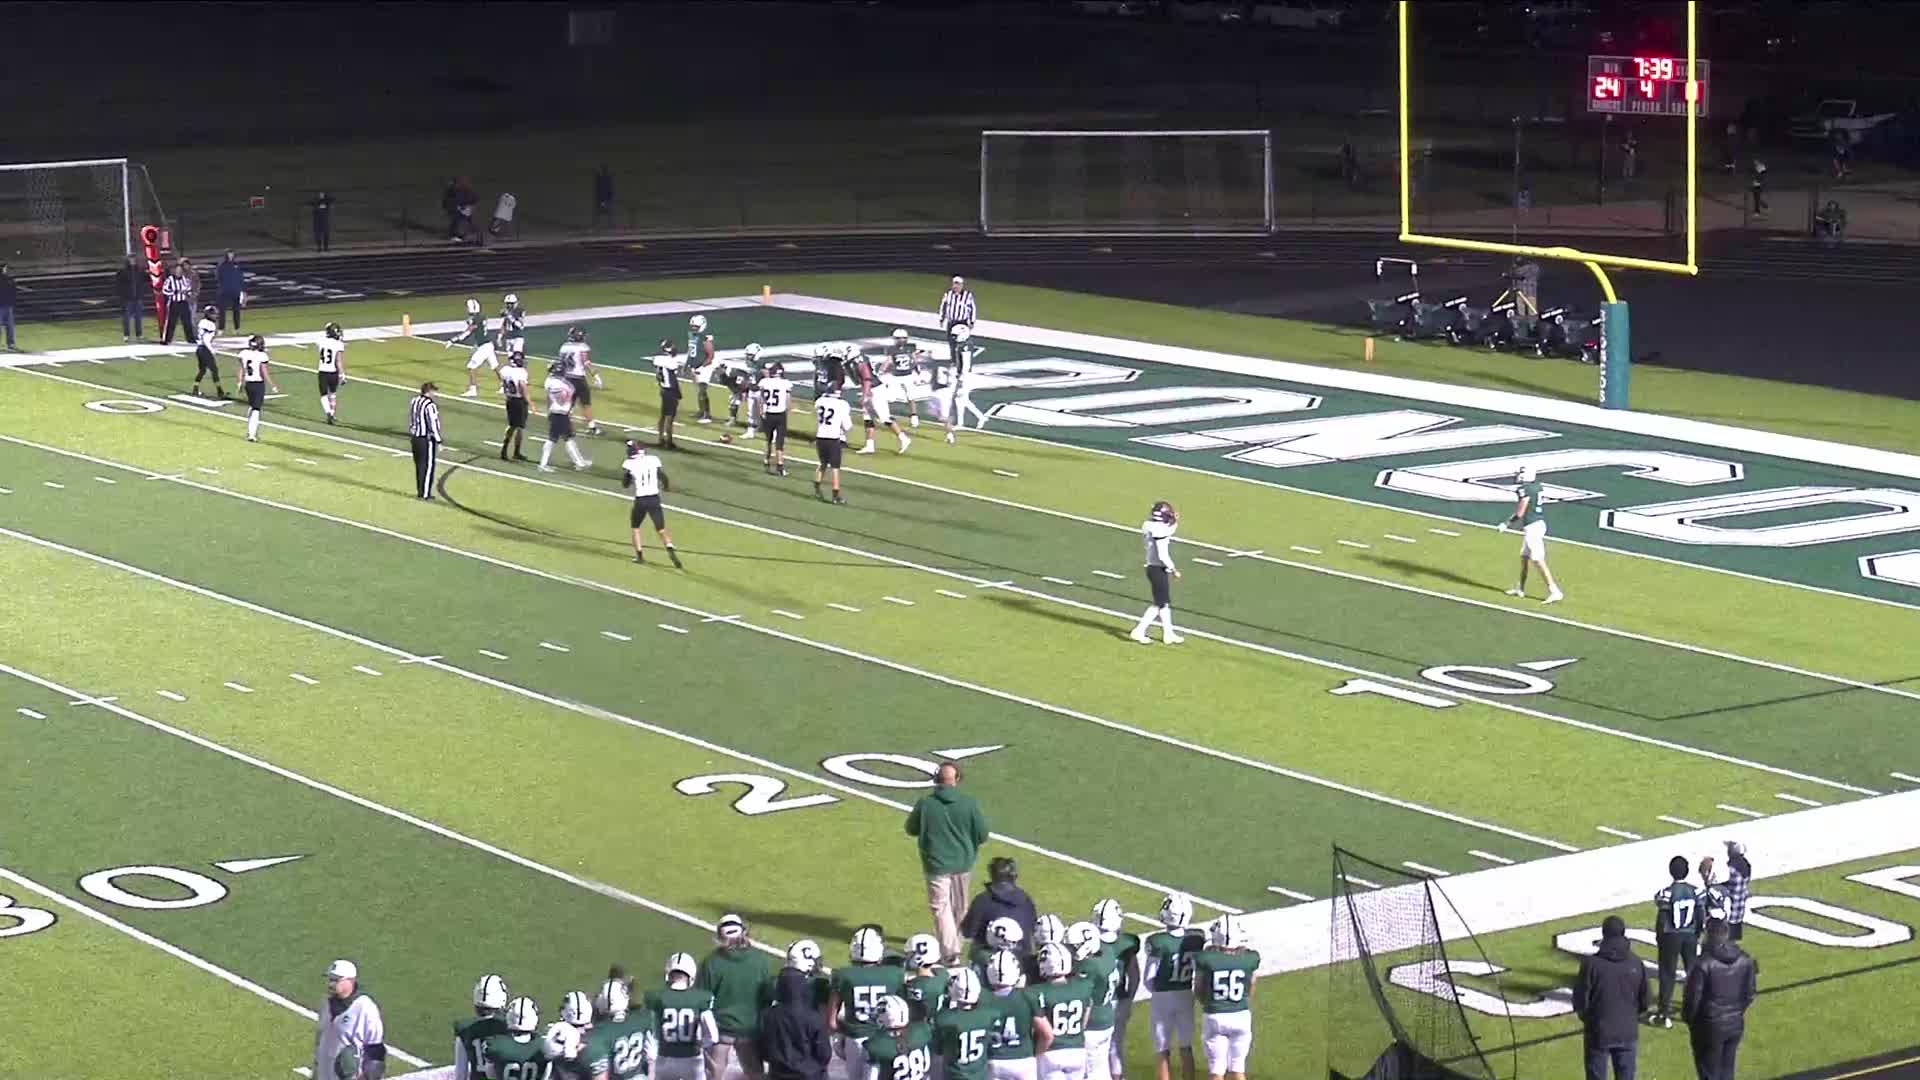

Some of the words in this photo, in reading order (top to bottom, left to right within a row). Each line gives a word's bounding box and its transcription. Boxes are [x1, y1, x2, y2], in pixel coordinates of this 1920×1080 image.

[1634, 57, 1673, 79] 7:39
[1595, 77, 1619, 98] 24
[1640, 80, 1653, 98] 4
[319, 346, 334, 365] 43
[763, 389, 780, 407] 25
[816, 404, 836, 426] 32
[641, 334, 1920, 590] BRONCO
[1328, 664, 1556, 709] 10
[673, 752, 942, 816] 20
[1672, 898, 1696, 929] 17
[1212, 968, 1246, 1002] 56
[661, 1007, 695, 1043] 20
[1052, 999, 1084, 1037] 62
[612, 1031, 645, 1075] 22
[958, 1028, 987, 1062] 15
[892, 1047, 926, 1080] 28
